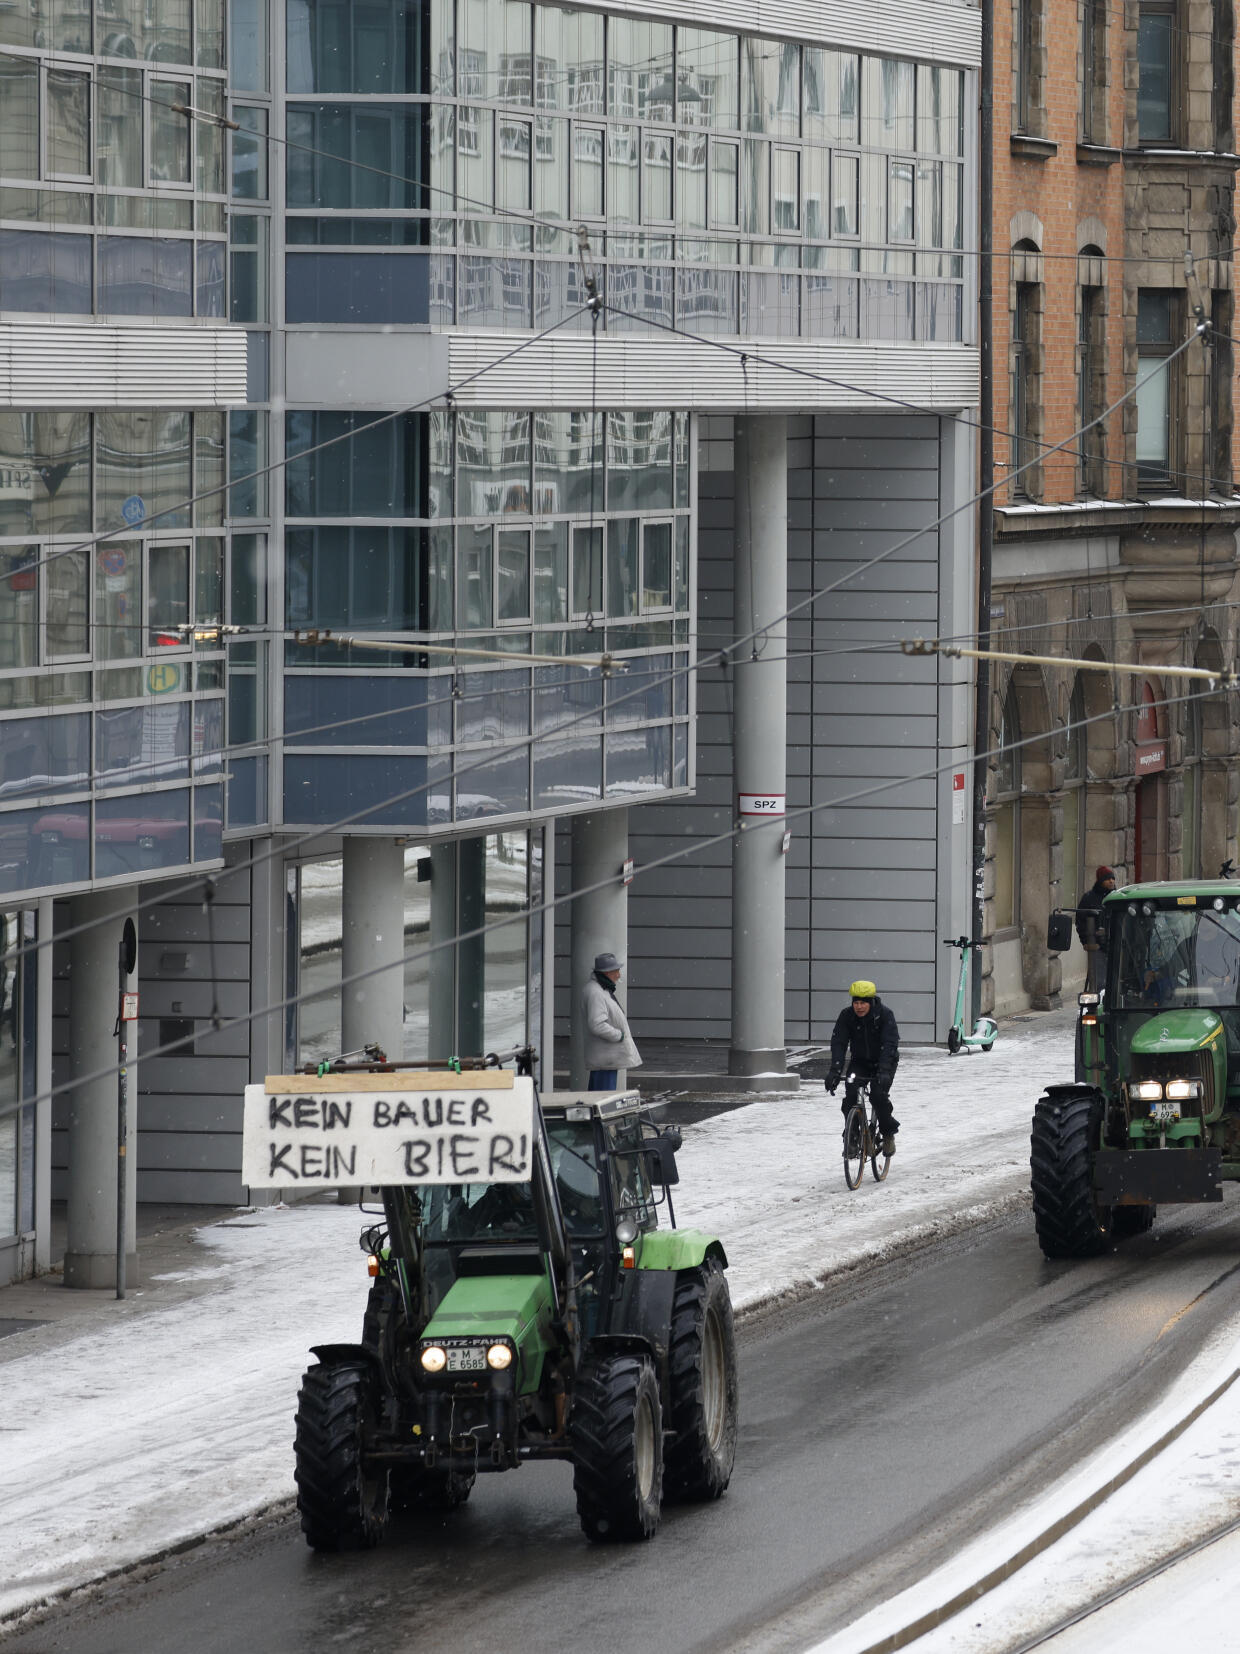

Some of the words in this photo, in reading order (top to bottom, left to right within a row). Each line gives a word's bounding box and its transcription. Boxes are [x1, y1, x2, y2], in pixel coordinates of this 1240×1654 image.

[754, 800, 777, 809] SPZ
[269, 1097, 352, 1131] KEIN
[373, 1098, 493, 1130] BAUER
[269, 1143, 357, 1179] KEIN
[401, 1133, 527, 1177] BIER!
[423, 1338, 508, 1347] DEUTZ-FAHR
[462, 1349, 471, 1359] M
[449, 1360, 456, 1370] E
[460, 1359, 484, 1370] 6585
